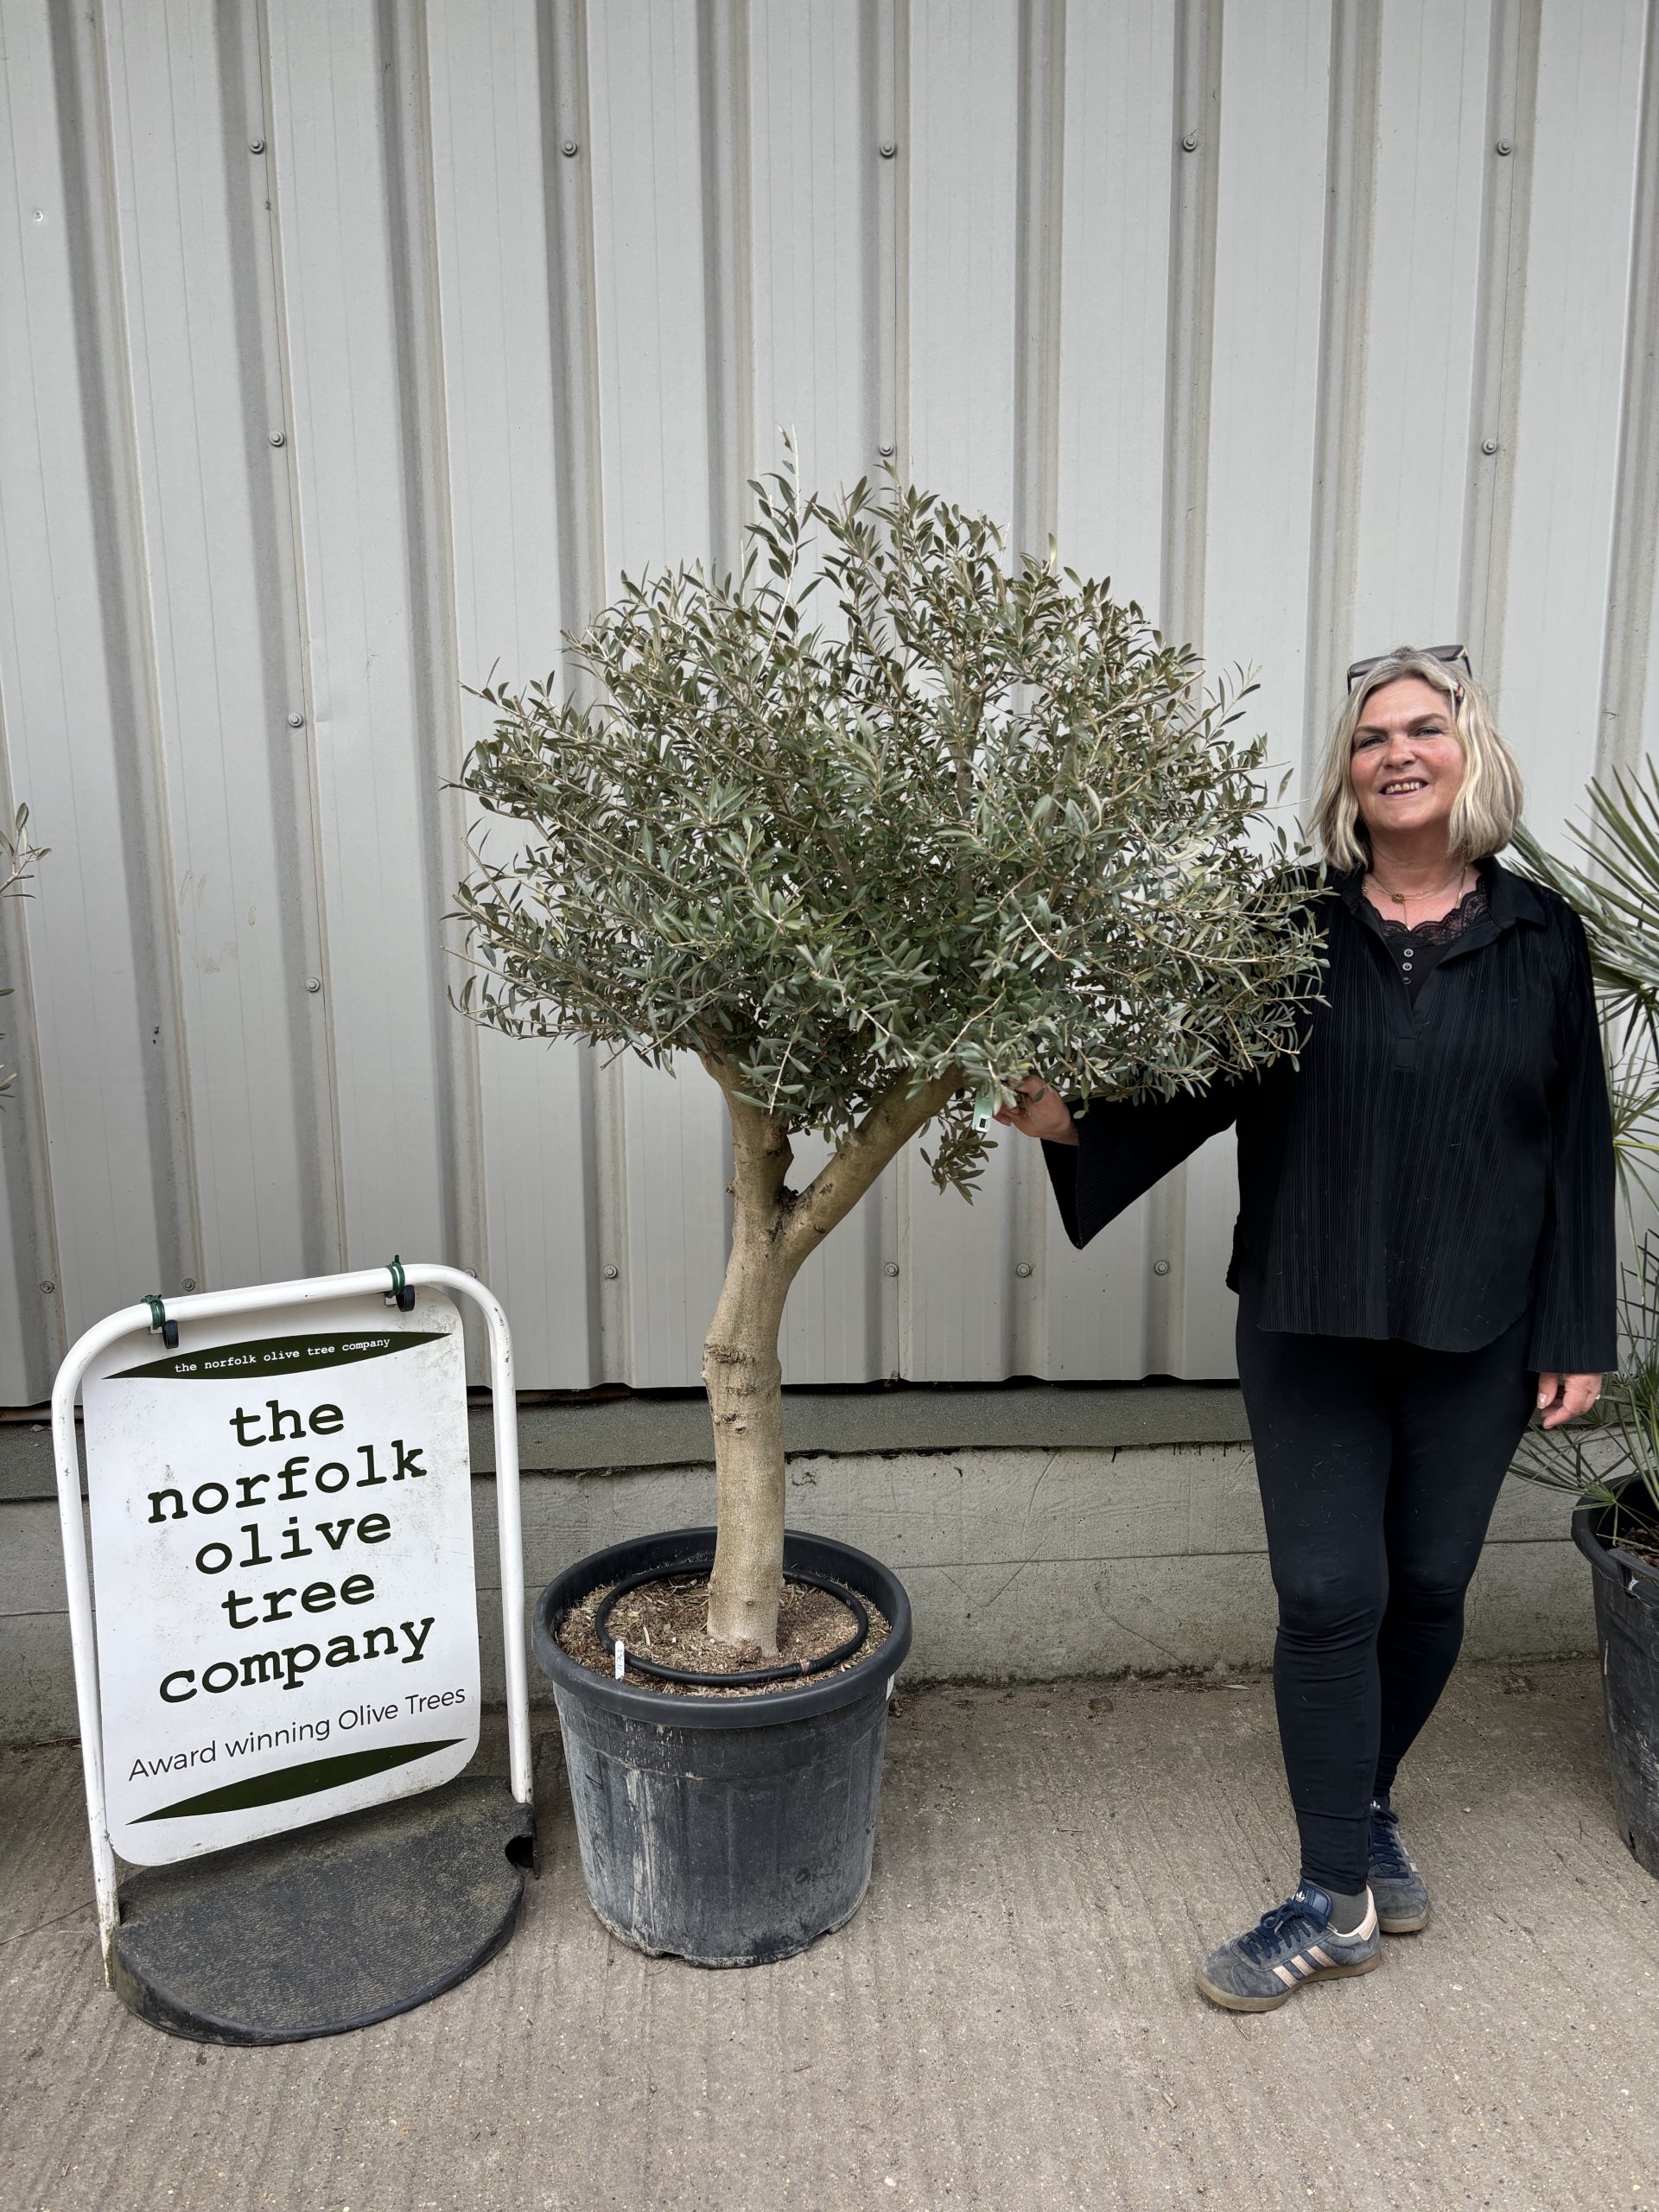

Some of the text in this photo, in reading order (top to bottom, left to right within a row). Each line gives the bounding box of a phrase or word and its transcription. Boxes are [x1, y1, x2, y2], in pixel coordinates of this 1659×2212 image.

[175, 1338, 391, 1373] the norfolk olive tree company
[230, 1400, 344, 1446] the
[148, 1440, 427, 1523] norfolk
[196, 1514, 391, 1574] olive
[221, 1573, 375, 1629] tree
[160, 1617, 435, 1703] company
[129, 1688, 466, 1782] Award winning Olive Trees
